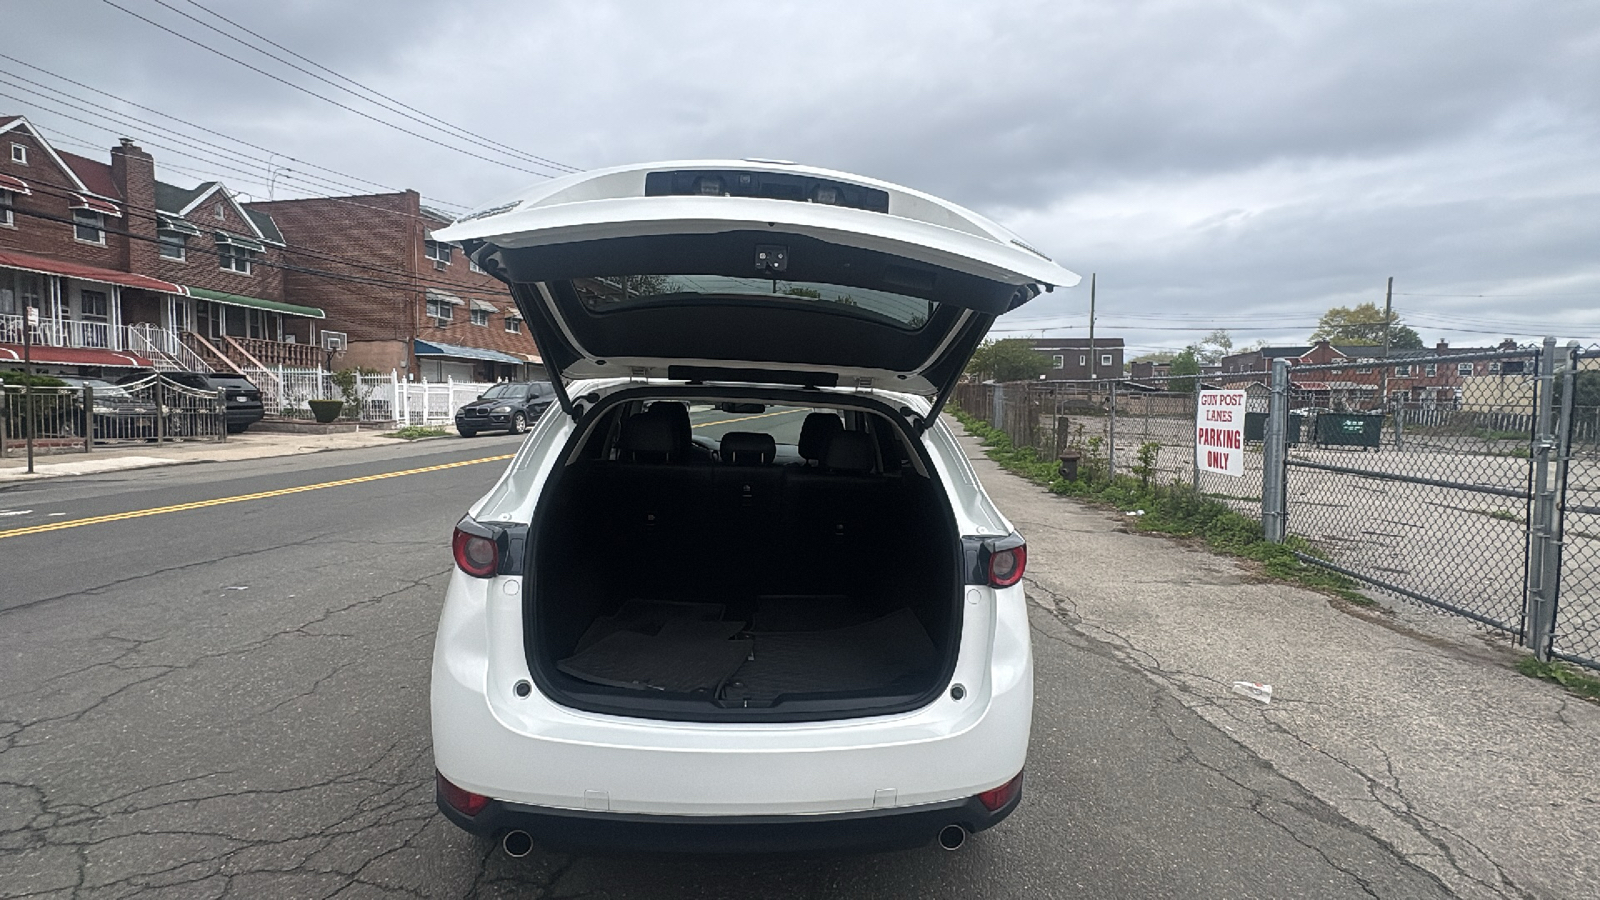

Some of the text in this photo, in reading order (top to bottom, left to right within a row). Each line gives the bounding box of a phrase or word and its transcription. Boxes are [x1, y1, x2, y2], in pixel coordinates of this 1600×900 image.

[1201, 394, 1243, 406] GUN POST
[1206, 409, 1232, 422] LANES
[1198, 427, 1241, 449] PARKING
[1207, 450, 1229, 470] ONLY
